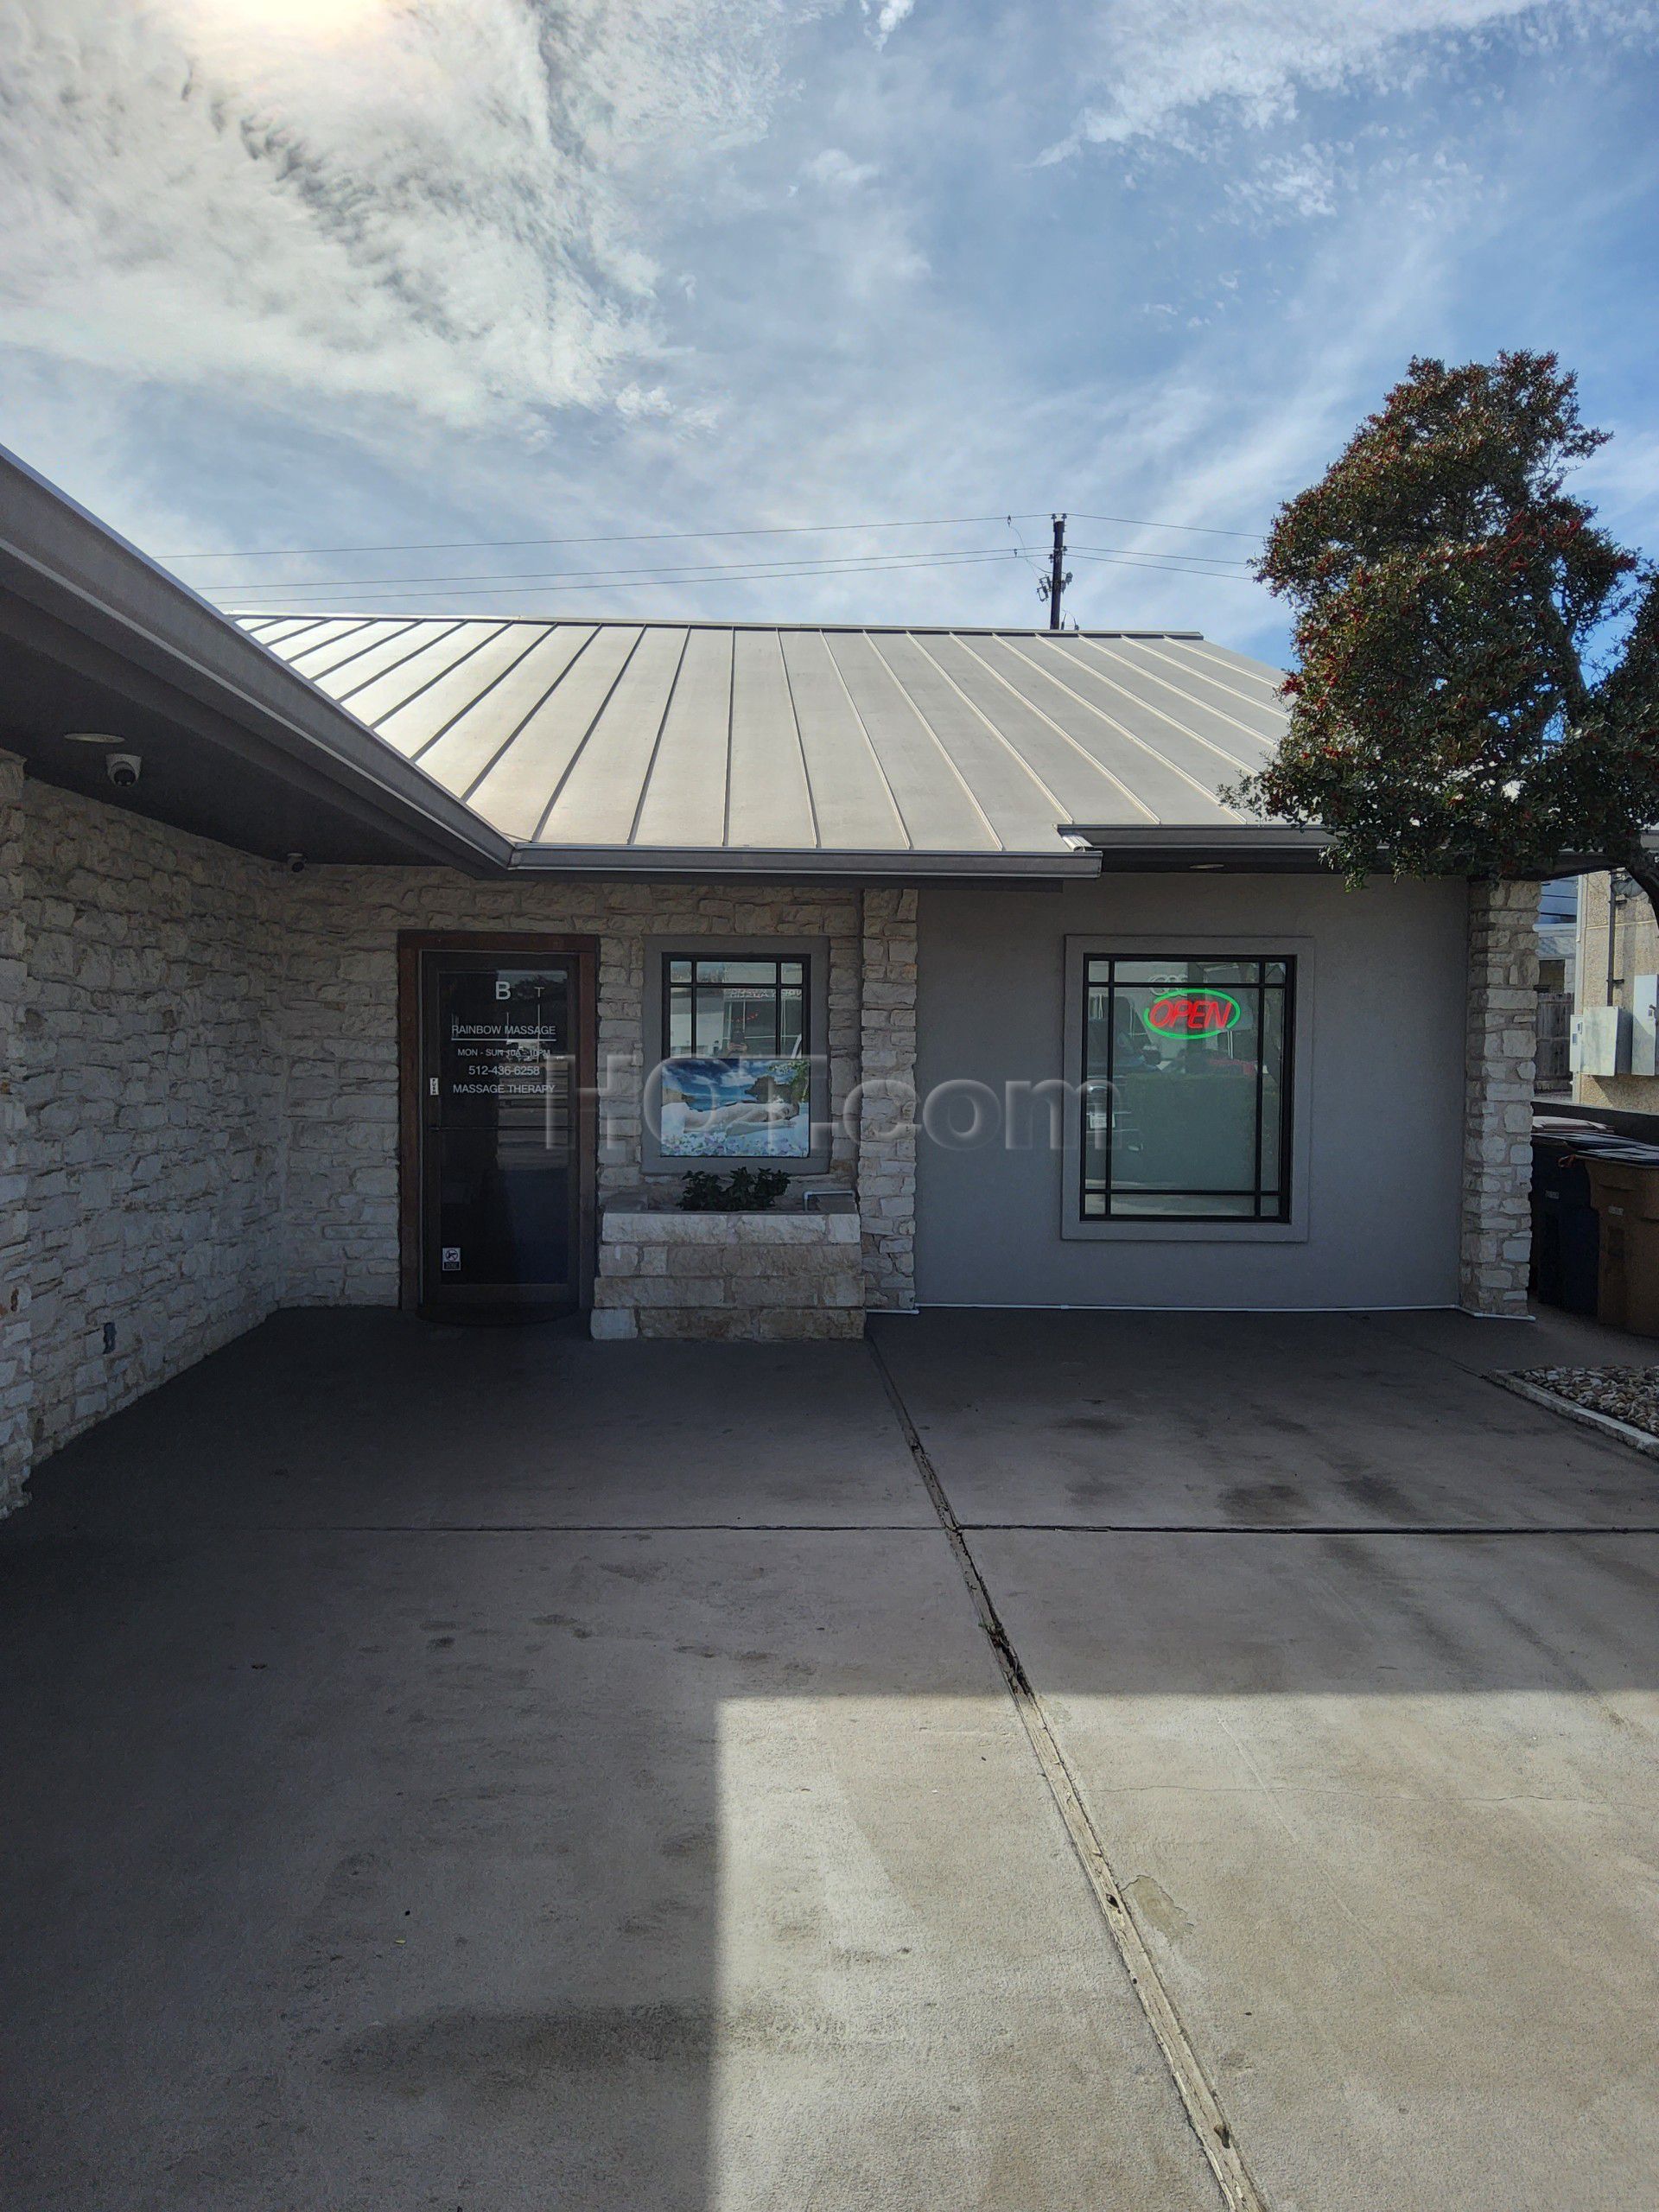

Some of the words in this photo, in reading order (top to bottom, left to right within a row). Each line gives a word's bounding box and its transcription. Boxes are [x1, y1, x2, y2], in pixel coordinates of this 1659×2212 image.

[495, 981, 512, 1000] B
[1149, 999, 1232, 1029] OPEN
[451, 1025, 502, 1035] RAINBOW
[504, 1025, 556, 1035] MASSAGE
[457, 1048, 478, 1057] MON
[486, 1048, 504, 1057] SUN
[468, 1065, 540, 1076] 512-436-6258
[453, 1084, 505, 1094] MASSAGE
[507, 1084, 556, 1094] THERAPY
